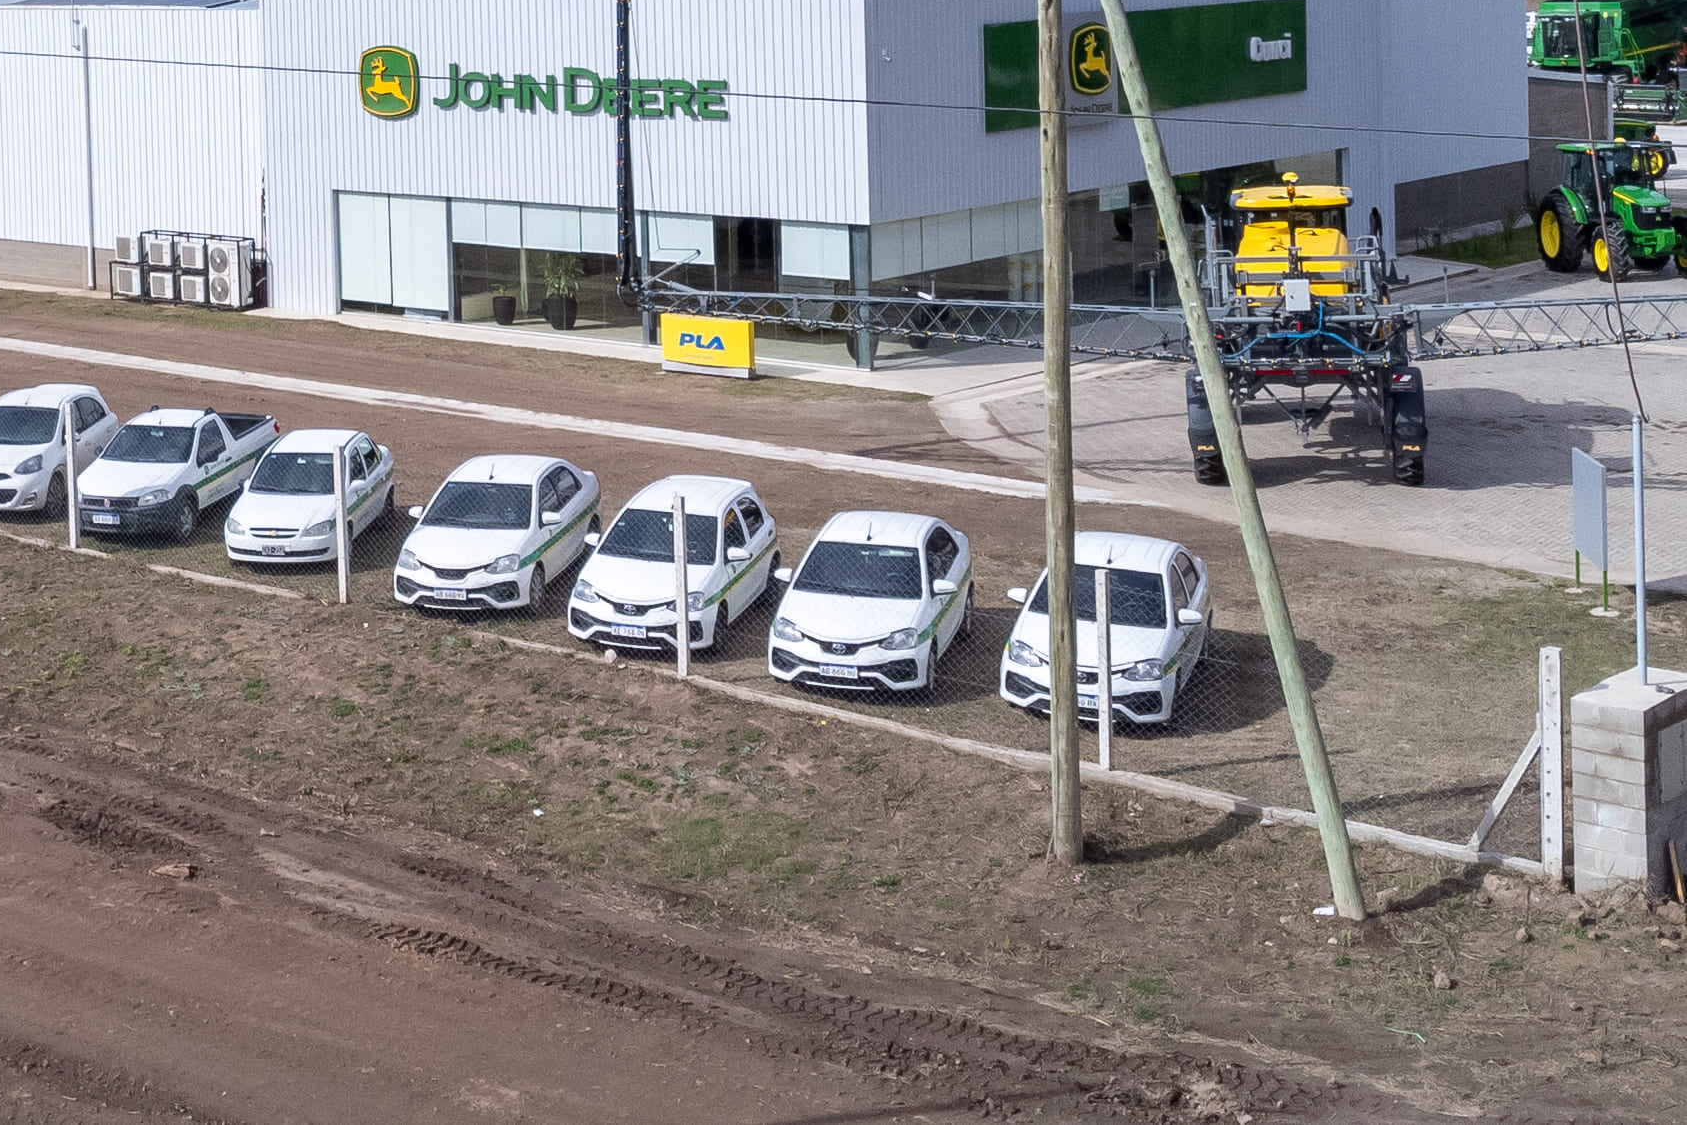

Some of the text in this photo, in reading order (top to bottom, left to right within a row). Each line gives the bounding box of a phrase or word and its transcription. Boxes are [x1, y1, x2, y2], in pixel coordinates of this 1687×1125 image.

[433, 63, 728, 118] JOHN DEERE
[679, 332, 726, 351] PLA
[1402, 444, 1421, 452] PLA
